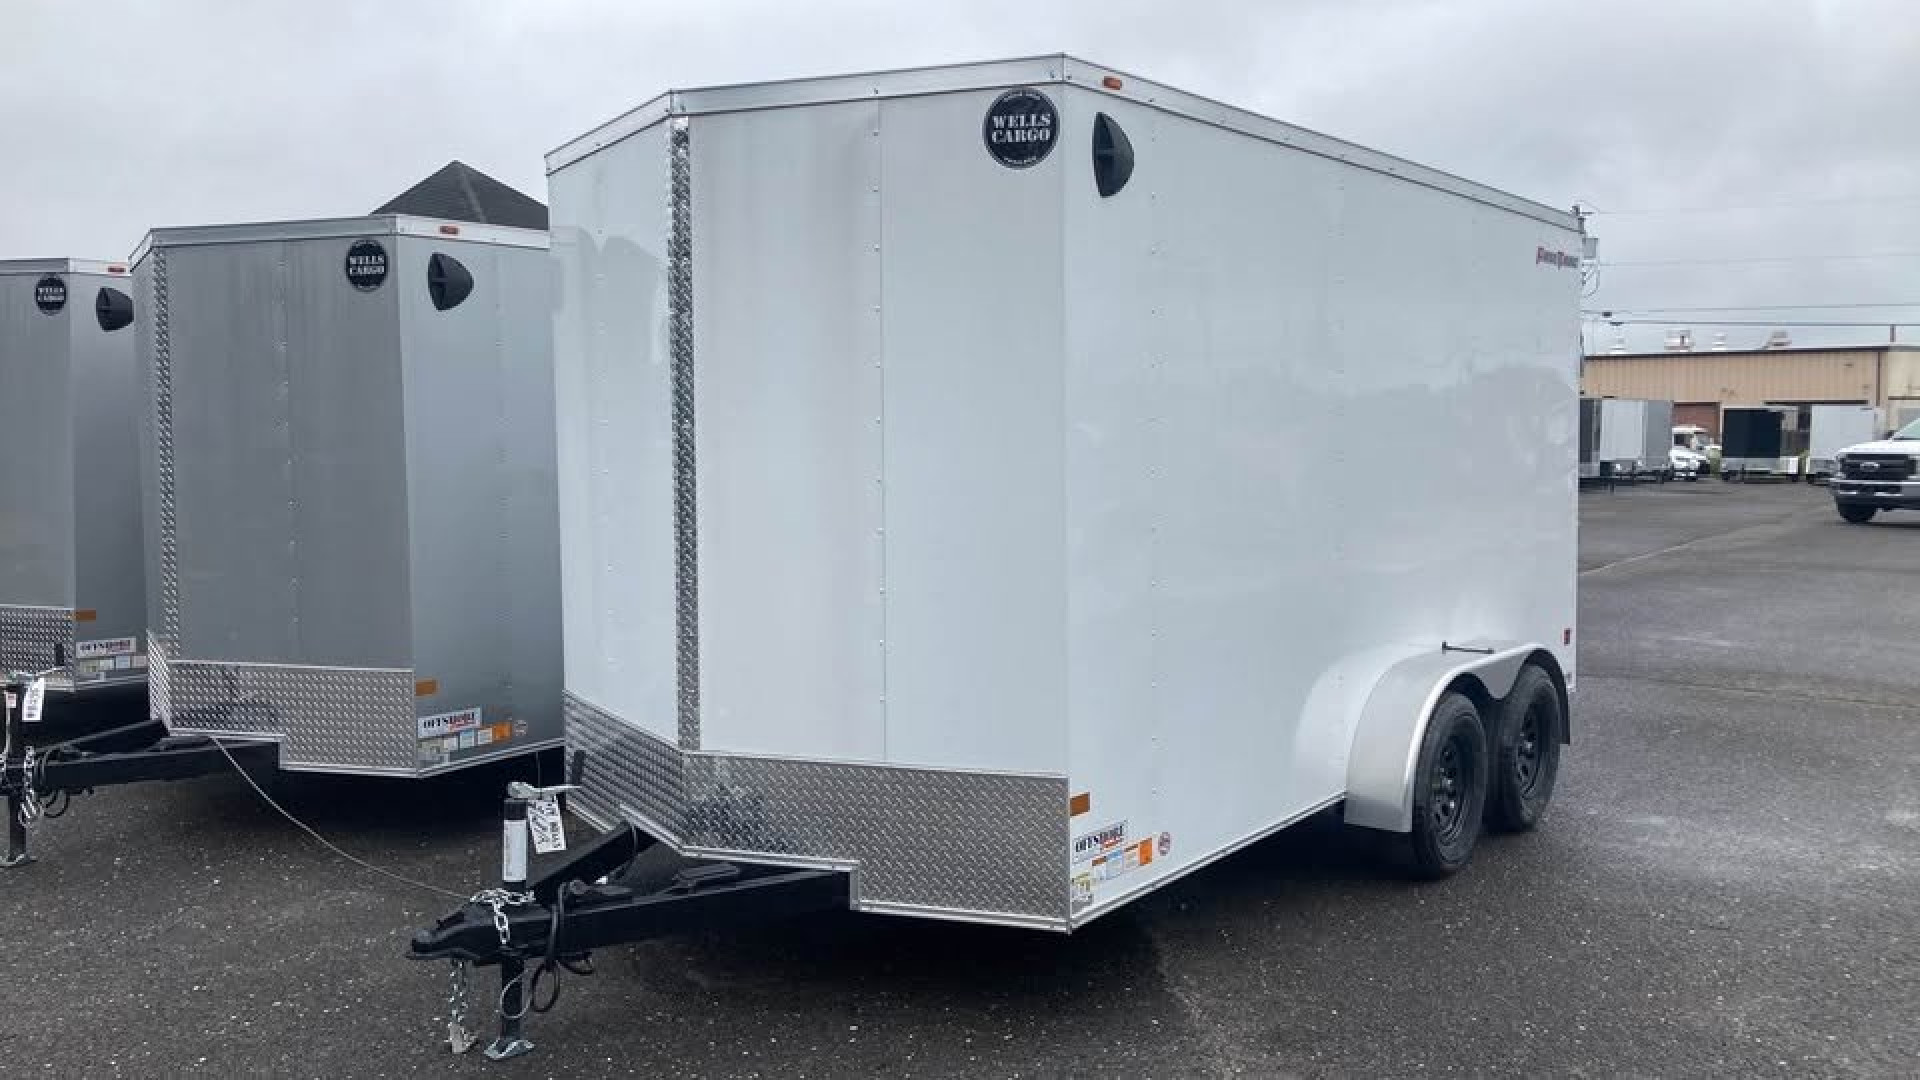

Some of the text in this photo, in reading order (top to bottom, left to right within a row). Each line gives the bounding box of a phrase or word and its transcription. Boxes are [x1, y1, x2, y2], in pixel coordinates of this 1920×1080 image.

[992, 114, 1051, 128] WELLS
[991, 129, 1051, 143] CARGO
[349, 255, 385, 265] WELLS
[349, 265, 385, 276] CARGO
